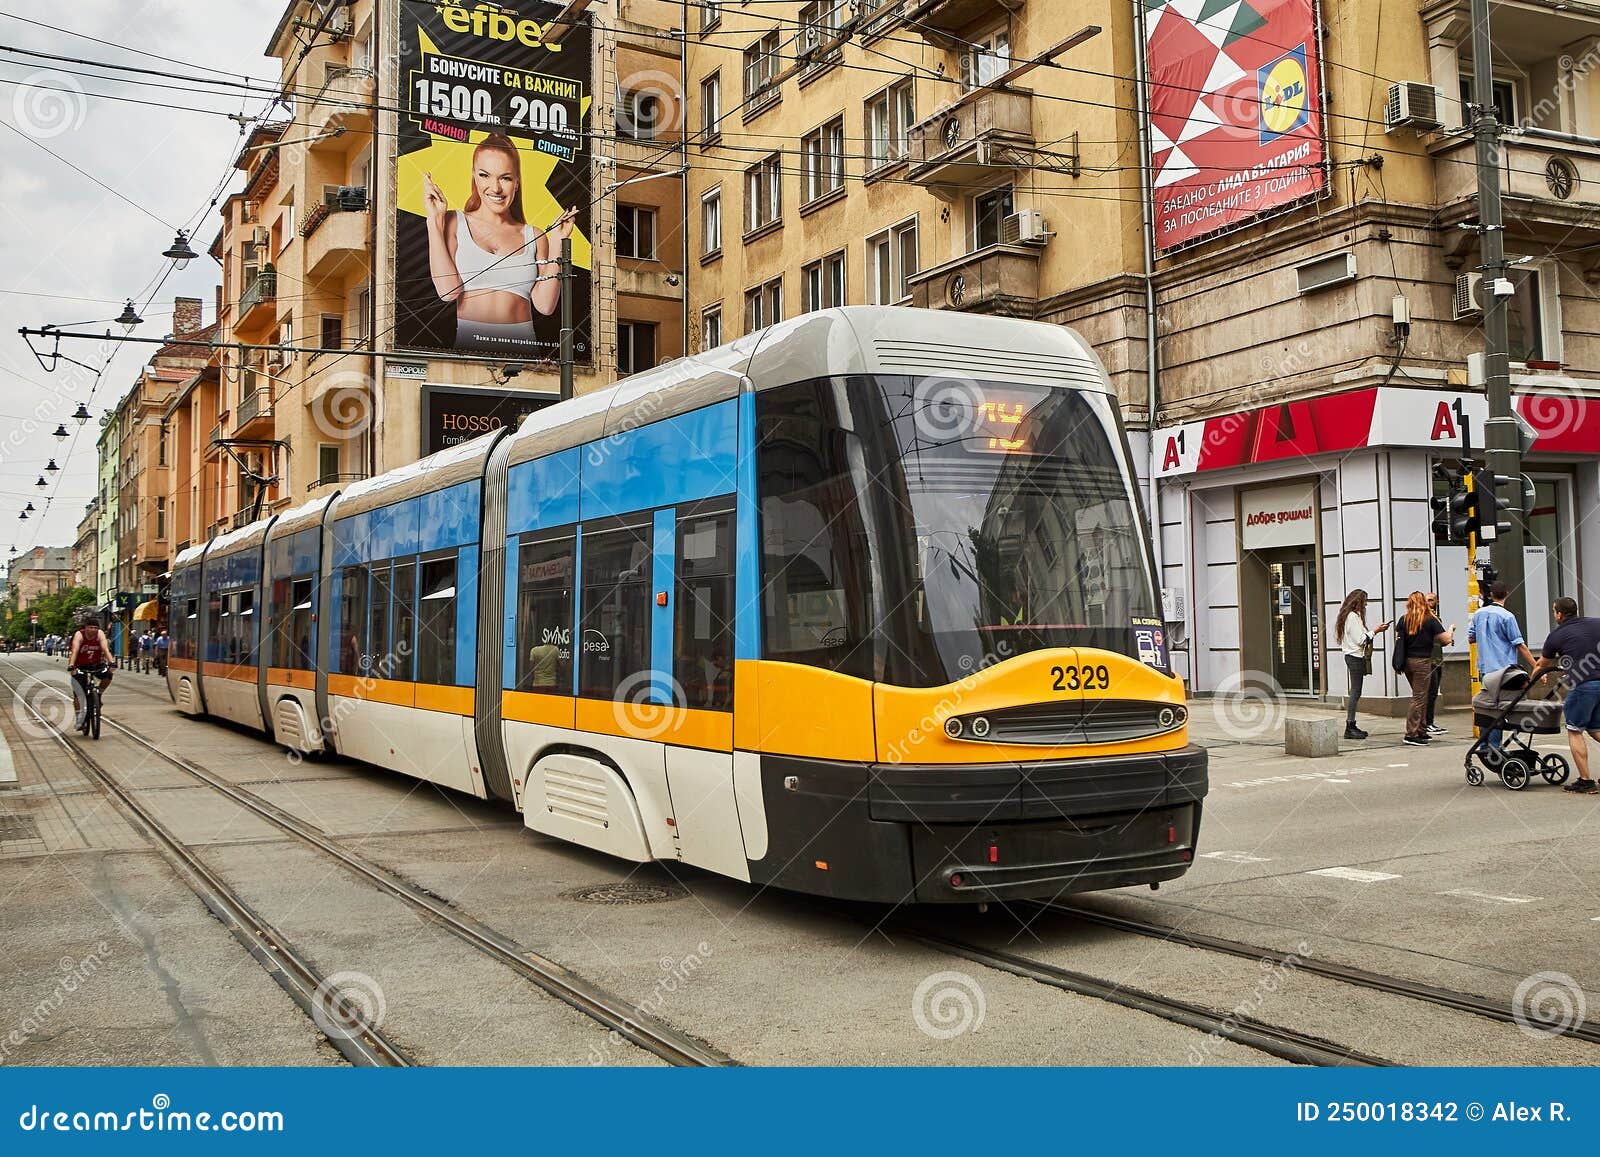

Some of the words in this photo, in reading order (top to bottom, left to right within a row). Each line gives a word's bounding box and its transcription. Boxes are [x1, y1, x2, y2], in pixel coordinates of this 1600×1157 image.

[430, 57, 500, 85] БОНУСИТЕ
[504, 71, 521, 89] СА
[525, 76, 576, 99] ВАЖНИ!
[424, 119, 467, 141] КАЗИНО!
[537, 139, 570, 159] СПОРТ!
[1163, 184, 1207, 215] ЗАЕДНО
[1217, 168, 1250, 195] ЛИДЛ
[1251, 141, 1310, 181] БЪЛГАРИЯ
[1163, 215, 1177, 233] ЗА
[1180, 189, 1251, 227] ПОСЛЕДНИТЕ
[1254, 185, 1261, 199] 3
[1264, 165, 1311, 195] ГОДИНИ
[442, 414, 502, 431] HOSSO
[1430, 397, 1462, 440] A1
[1163, 429, 1185, 472] A1
[1246, 511, 1276, 527] Добре
[1277, 506, 1313, 524] дошли!
[541, 625, 570, 645] SWING
[583, 641, 606, 653] pesa
[1050, 664, 1110, 691] 2329
